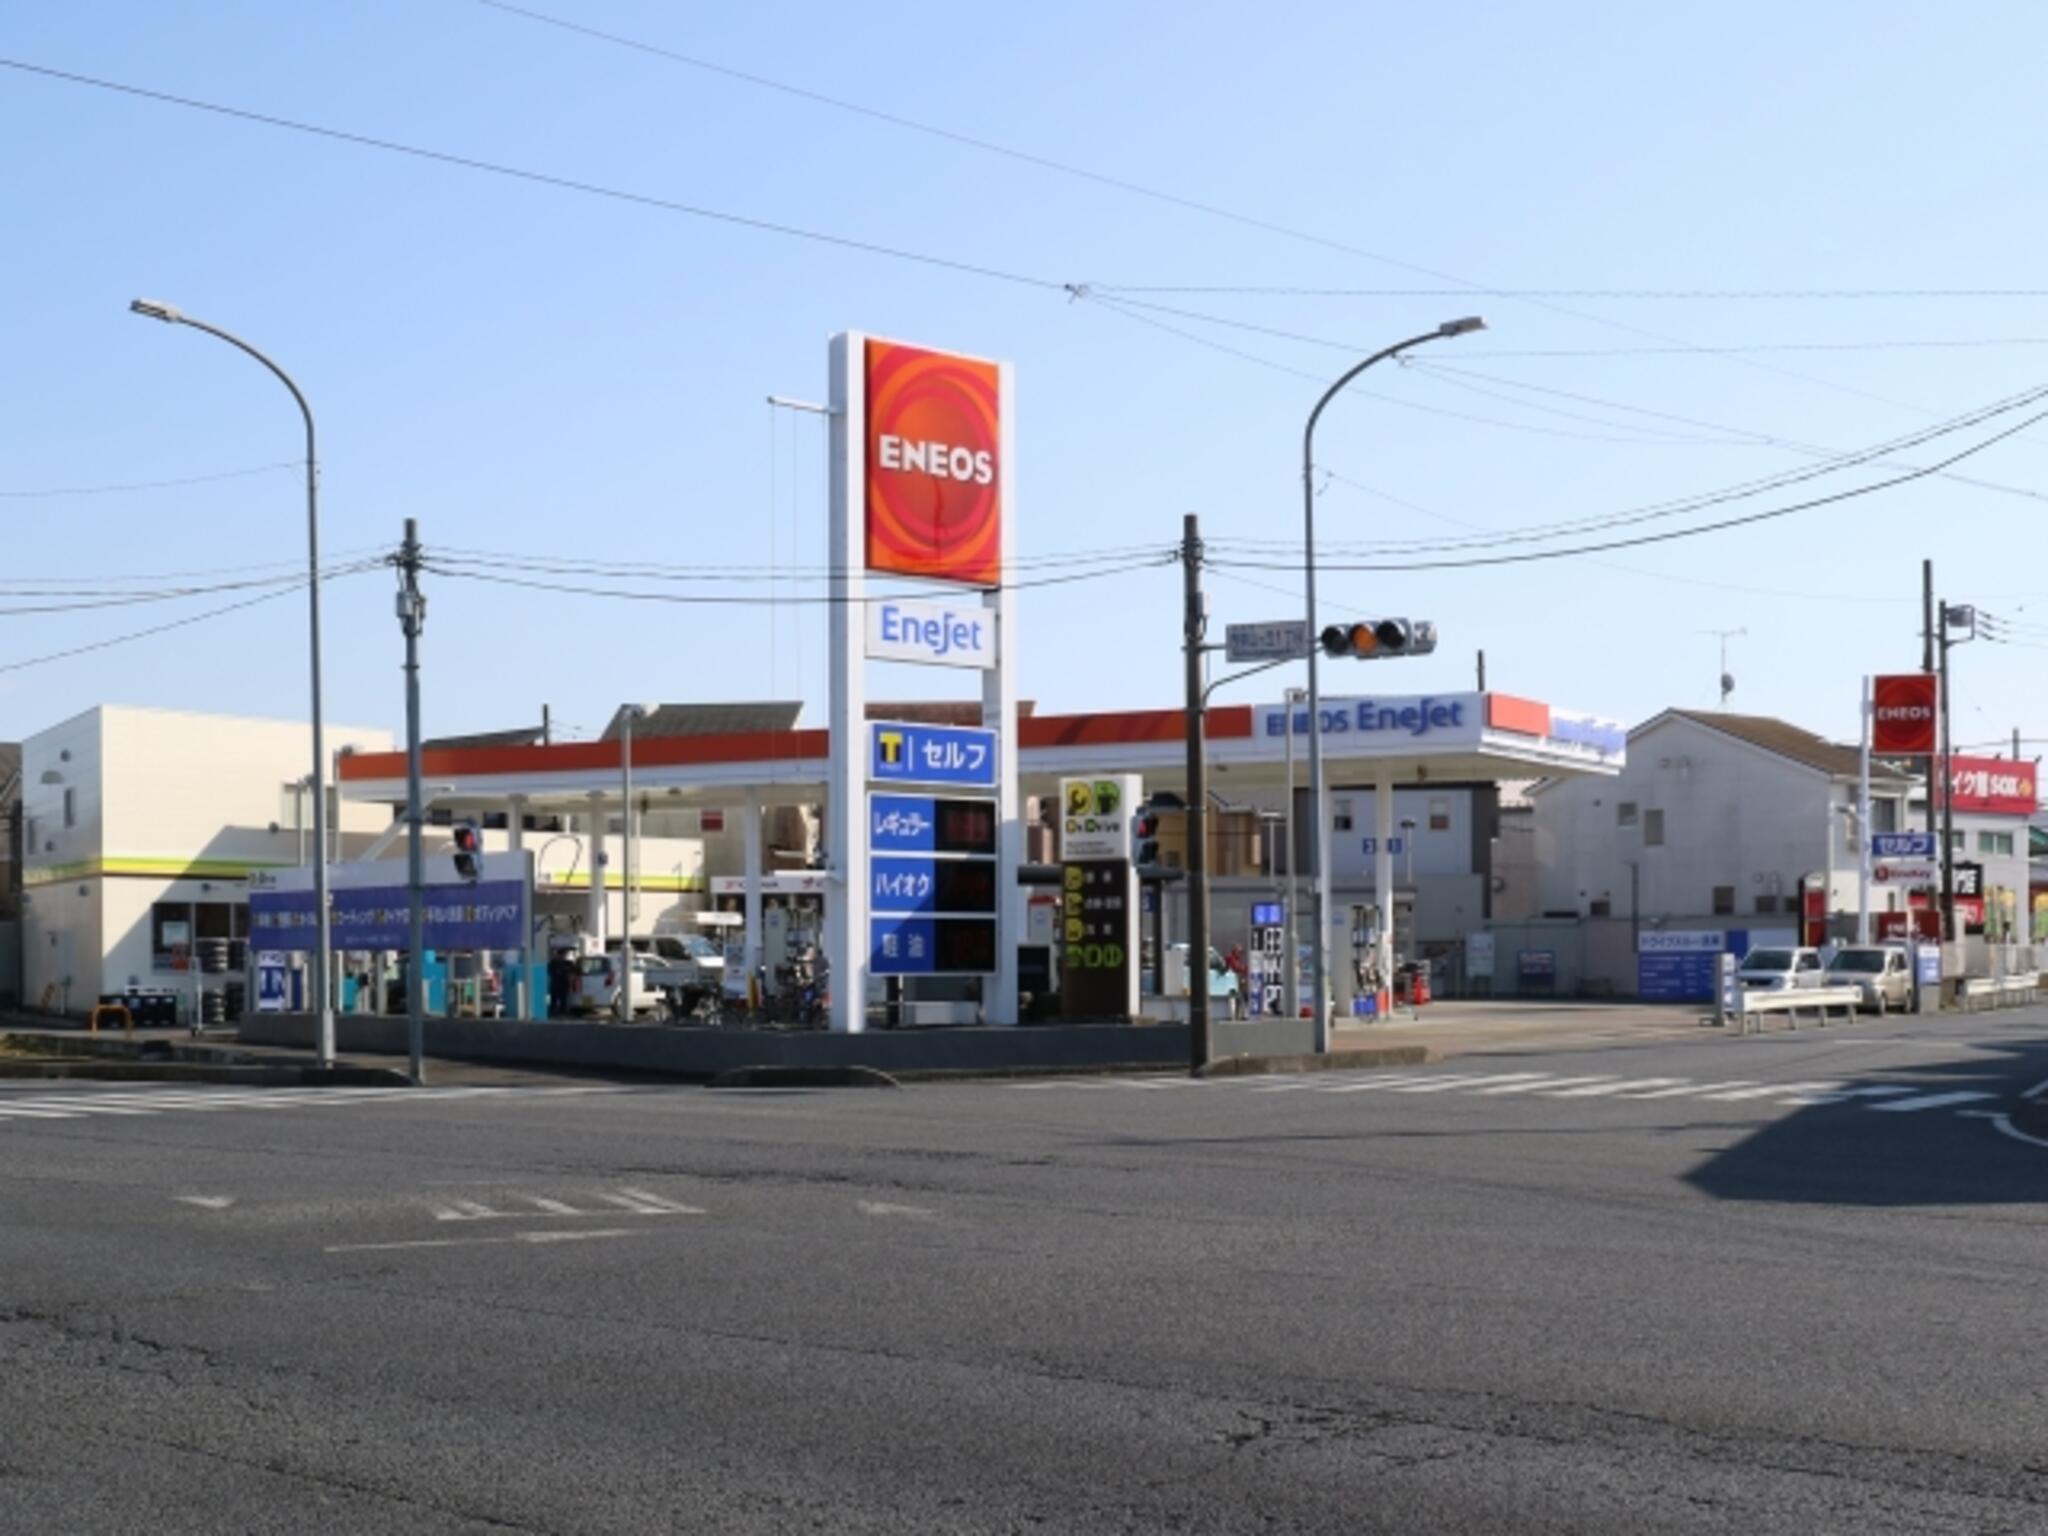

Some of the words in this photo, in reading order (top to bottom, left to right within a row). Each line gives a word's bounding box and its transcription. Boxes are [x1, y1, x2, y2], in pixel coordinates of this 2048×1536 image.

[879, 434, 993, 485] ENEOS
[881, 605, 982, 655] EneJet
[1877, 706, 1931, 720] ENEOS
[879, 732, 902, 764] T
[921, 738, 987, 771] セルフ
[873, 811, 932, 837] レギュラー
[1879, 837, 1928, 853] セルフ
[875, 872, 930, 897] ハイオク
